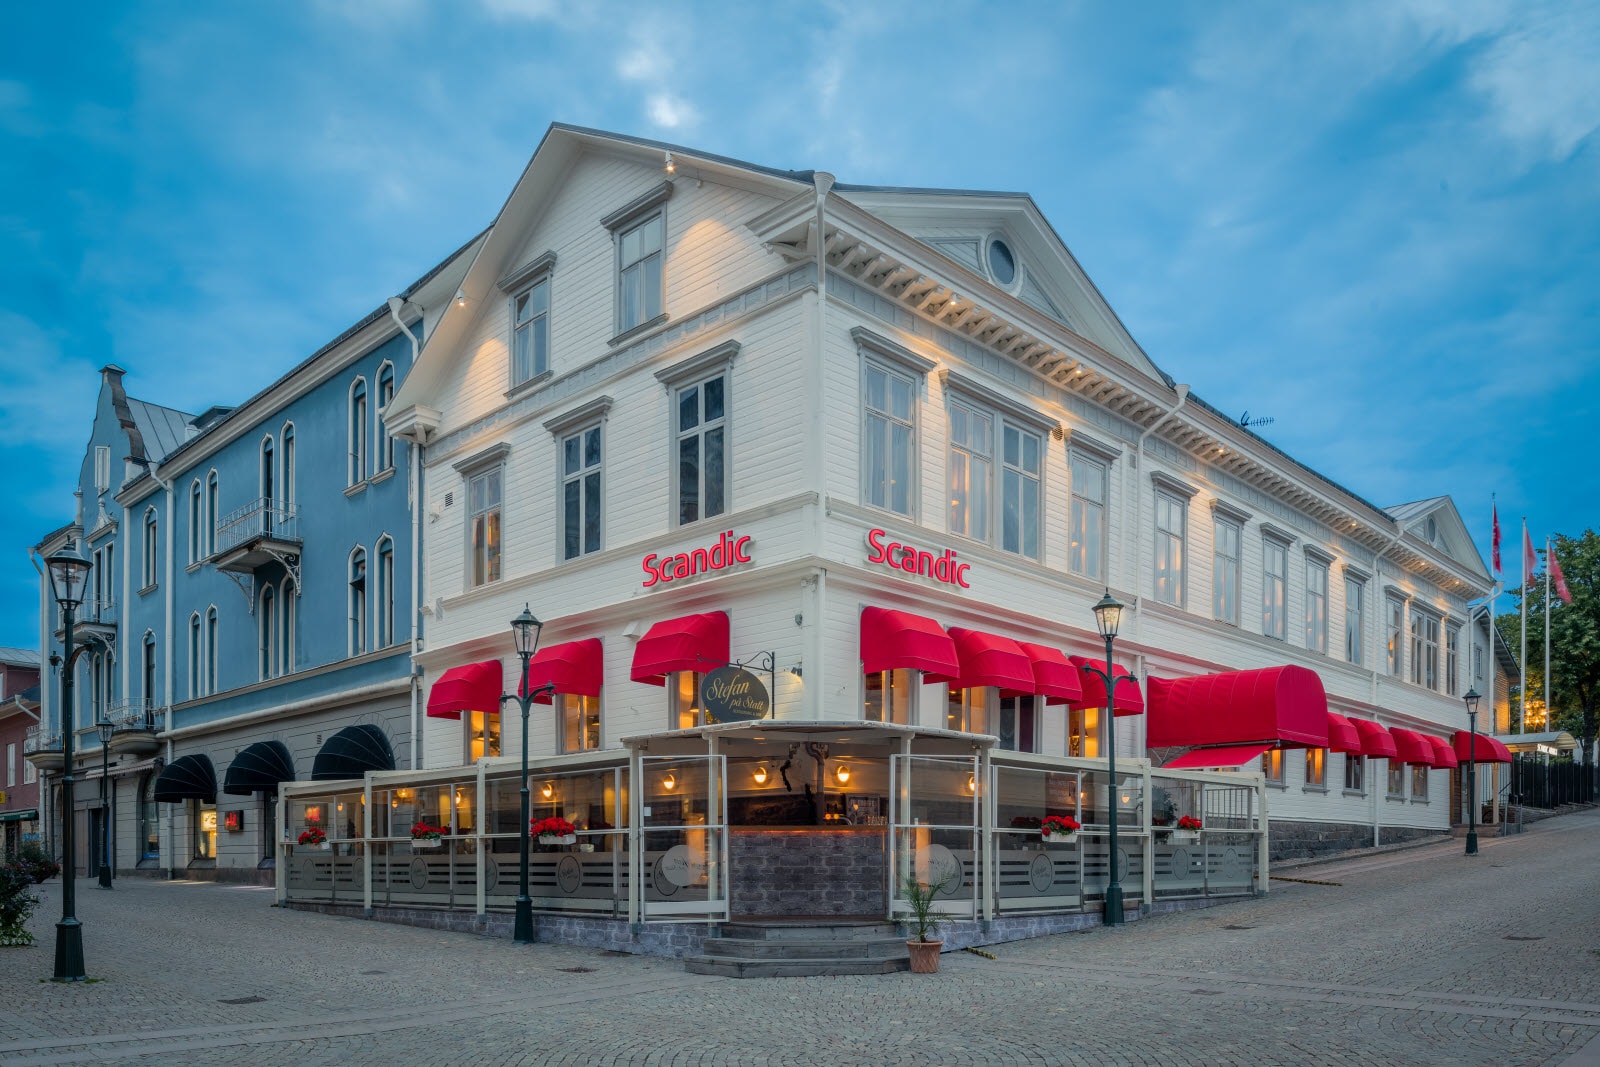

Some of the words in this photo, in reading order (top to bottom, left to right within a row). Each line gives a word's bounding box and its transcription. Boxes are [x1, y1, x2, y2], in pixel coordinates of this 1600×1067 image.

[642, 530, 751, 587] Scandic
[868, 528, 970, 588] Scandic
[706, 674, 750, 704] Stefan
[729, 697, 741, 710] på
[742, 695, 765, 711] Statt
